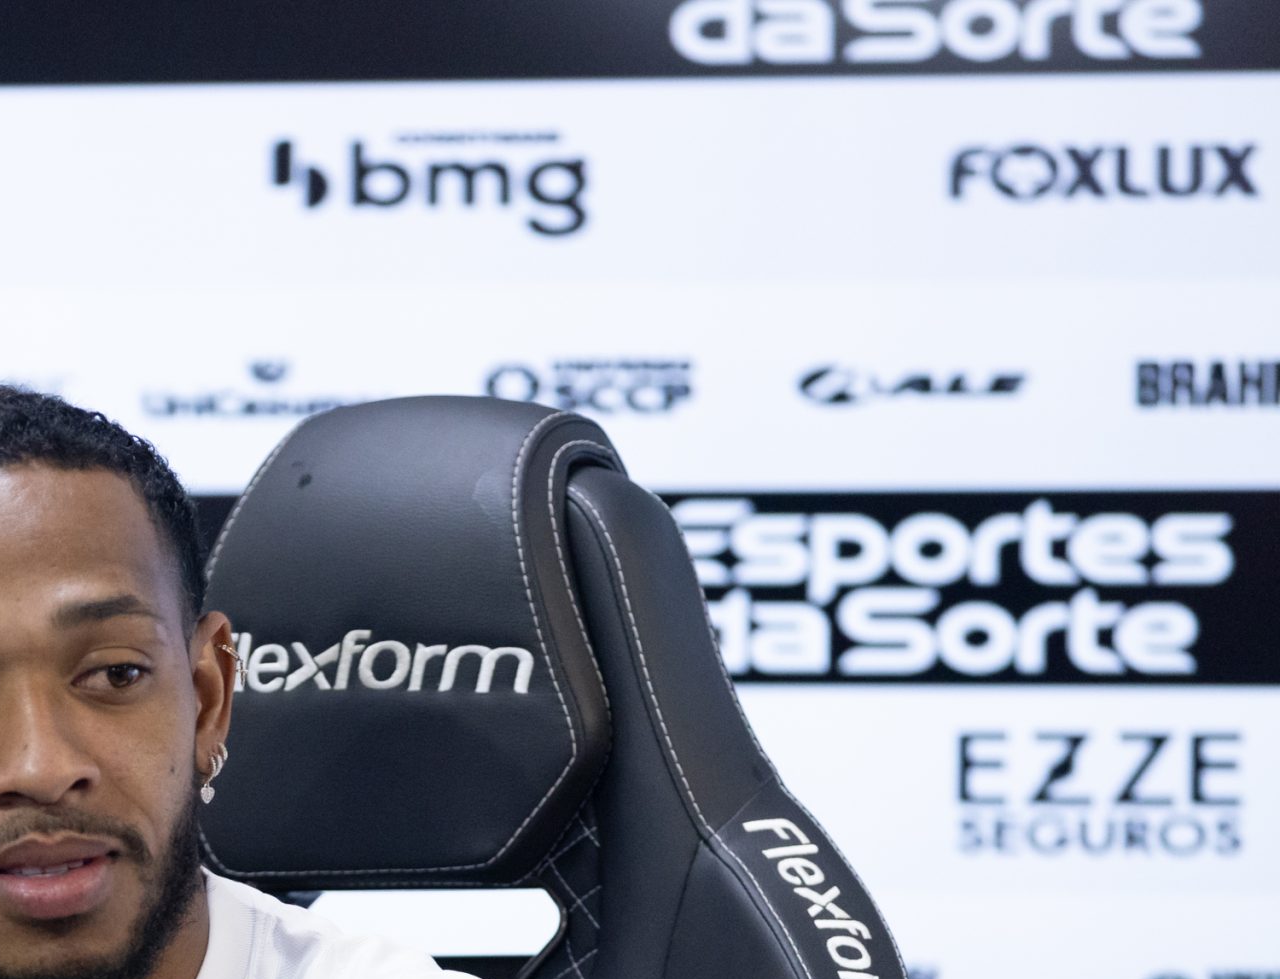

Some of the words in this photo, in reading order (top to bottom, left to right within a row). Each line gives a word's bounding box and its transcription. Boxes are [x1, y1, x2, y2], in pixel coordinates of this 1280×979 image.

[840, 0, 1207, 62] Sorte
[352, 139, 588, 237] bmg
[951, 145, 1258, 199] FOXLUX
[1137, 361, 1280, 406] BRAH
[671, 497, 1234, 604] Esportes
[231, 629, 535, 694] lexform
[835, 584, 1200, 676] Sorte
[958, 732, 1242, 805] EZZE
[960, 813, 1242, 855] SEGUROS
